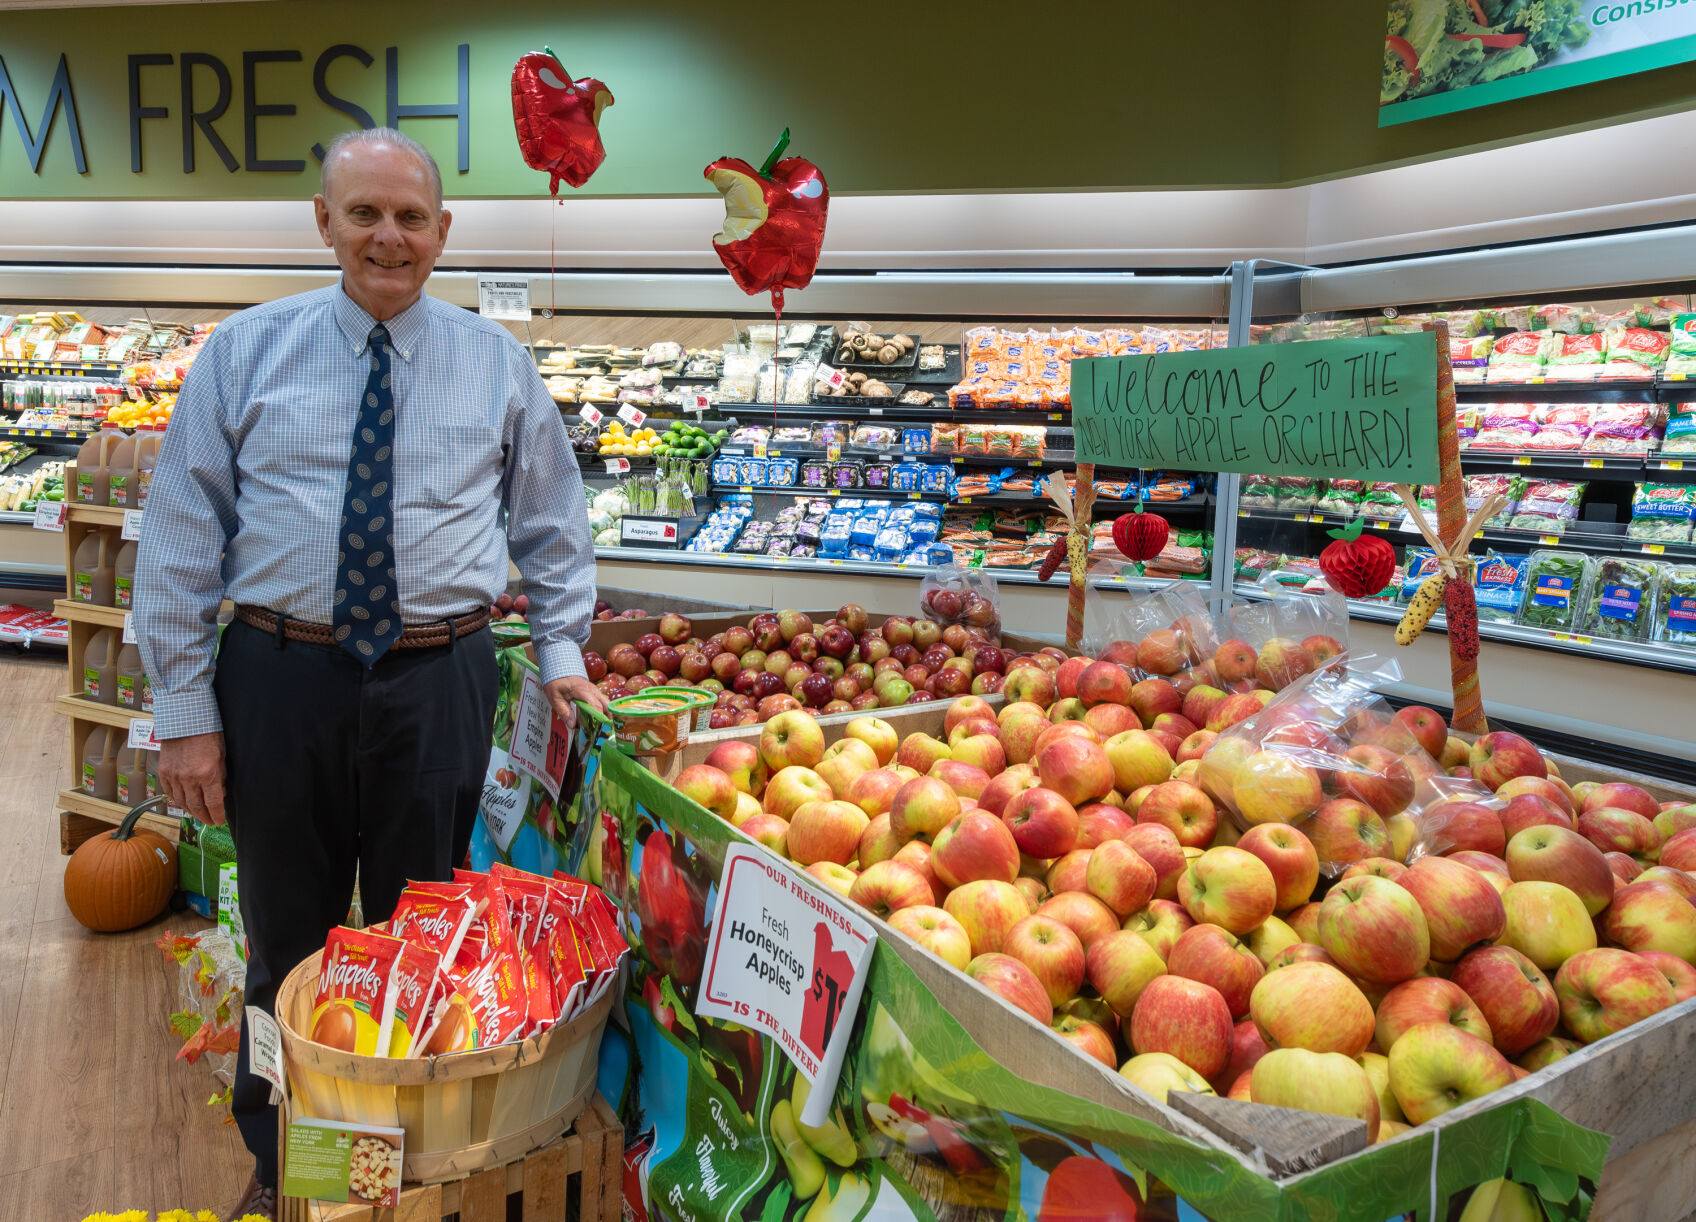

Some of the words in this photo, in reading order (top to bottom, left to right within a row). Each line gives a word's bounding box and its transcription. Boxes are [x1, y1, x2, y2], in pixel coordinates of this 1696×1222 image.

[128, 44, 469, 175] FRESH
[1091, 356, 1297, 415] Welcome
[1305, 358, 1331, 398] TO
[1344, 351, 1398, 398] THE
[1078, 416, 1111, 458] NEW
[1112, 416, 1165, 462] YORK
[1174, 414, 1250, 463] APPLE
[1263, 408, 1413, 470] ORCHARD!
[1637, 503, 1657, 511] SWEET
[1658, 504, 1684, 512] BUTTER
[630, 528, 658, 536] Asparagus
[525, 733, 542, 754] Apples
[527, 719, 544, 740] Empire
[481, 784, 517, 809] Apples
[220, 896, 230, 905] KIT
[766, 865, 788, 889] OUR
[790, 880, 854, 936] FRESHNESS
[762, 906, 789, 942] Fresh
[730, 920, 805, 982] Honeycrisp
[745, 952, 791, 996] Apples
[733, 1000, 750, 1017] IS
[756, 1007, 780, 1034] THE
[708, 1097, 739, 1151] Juicy
